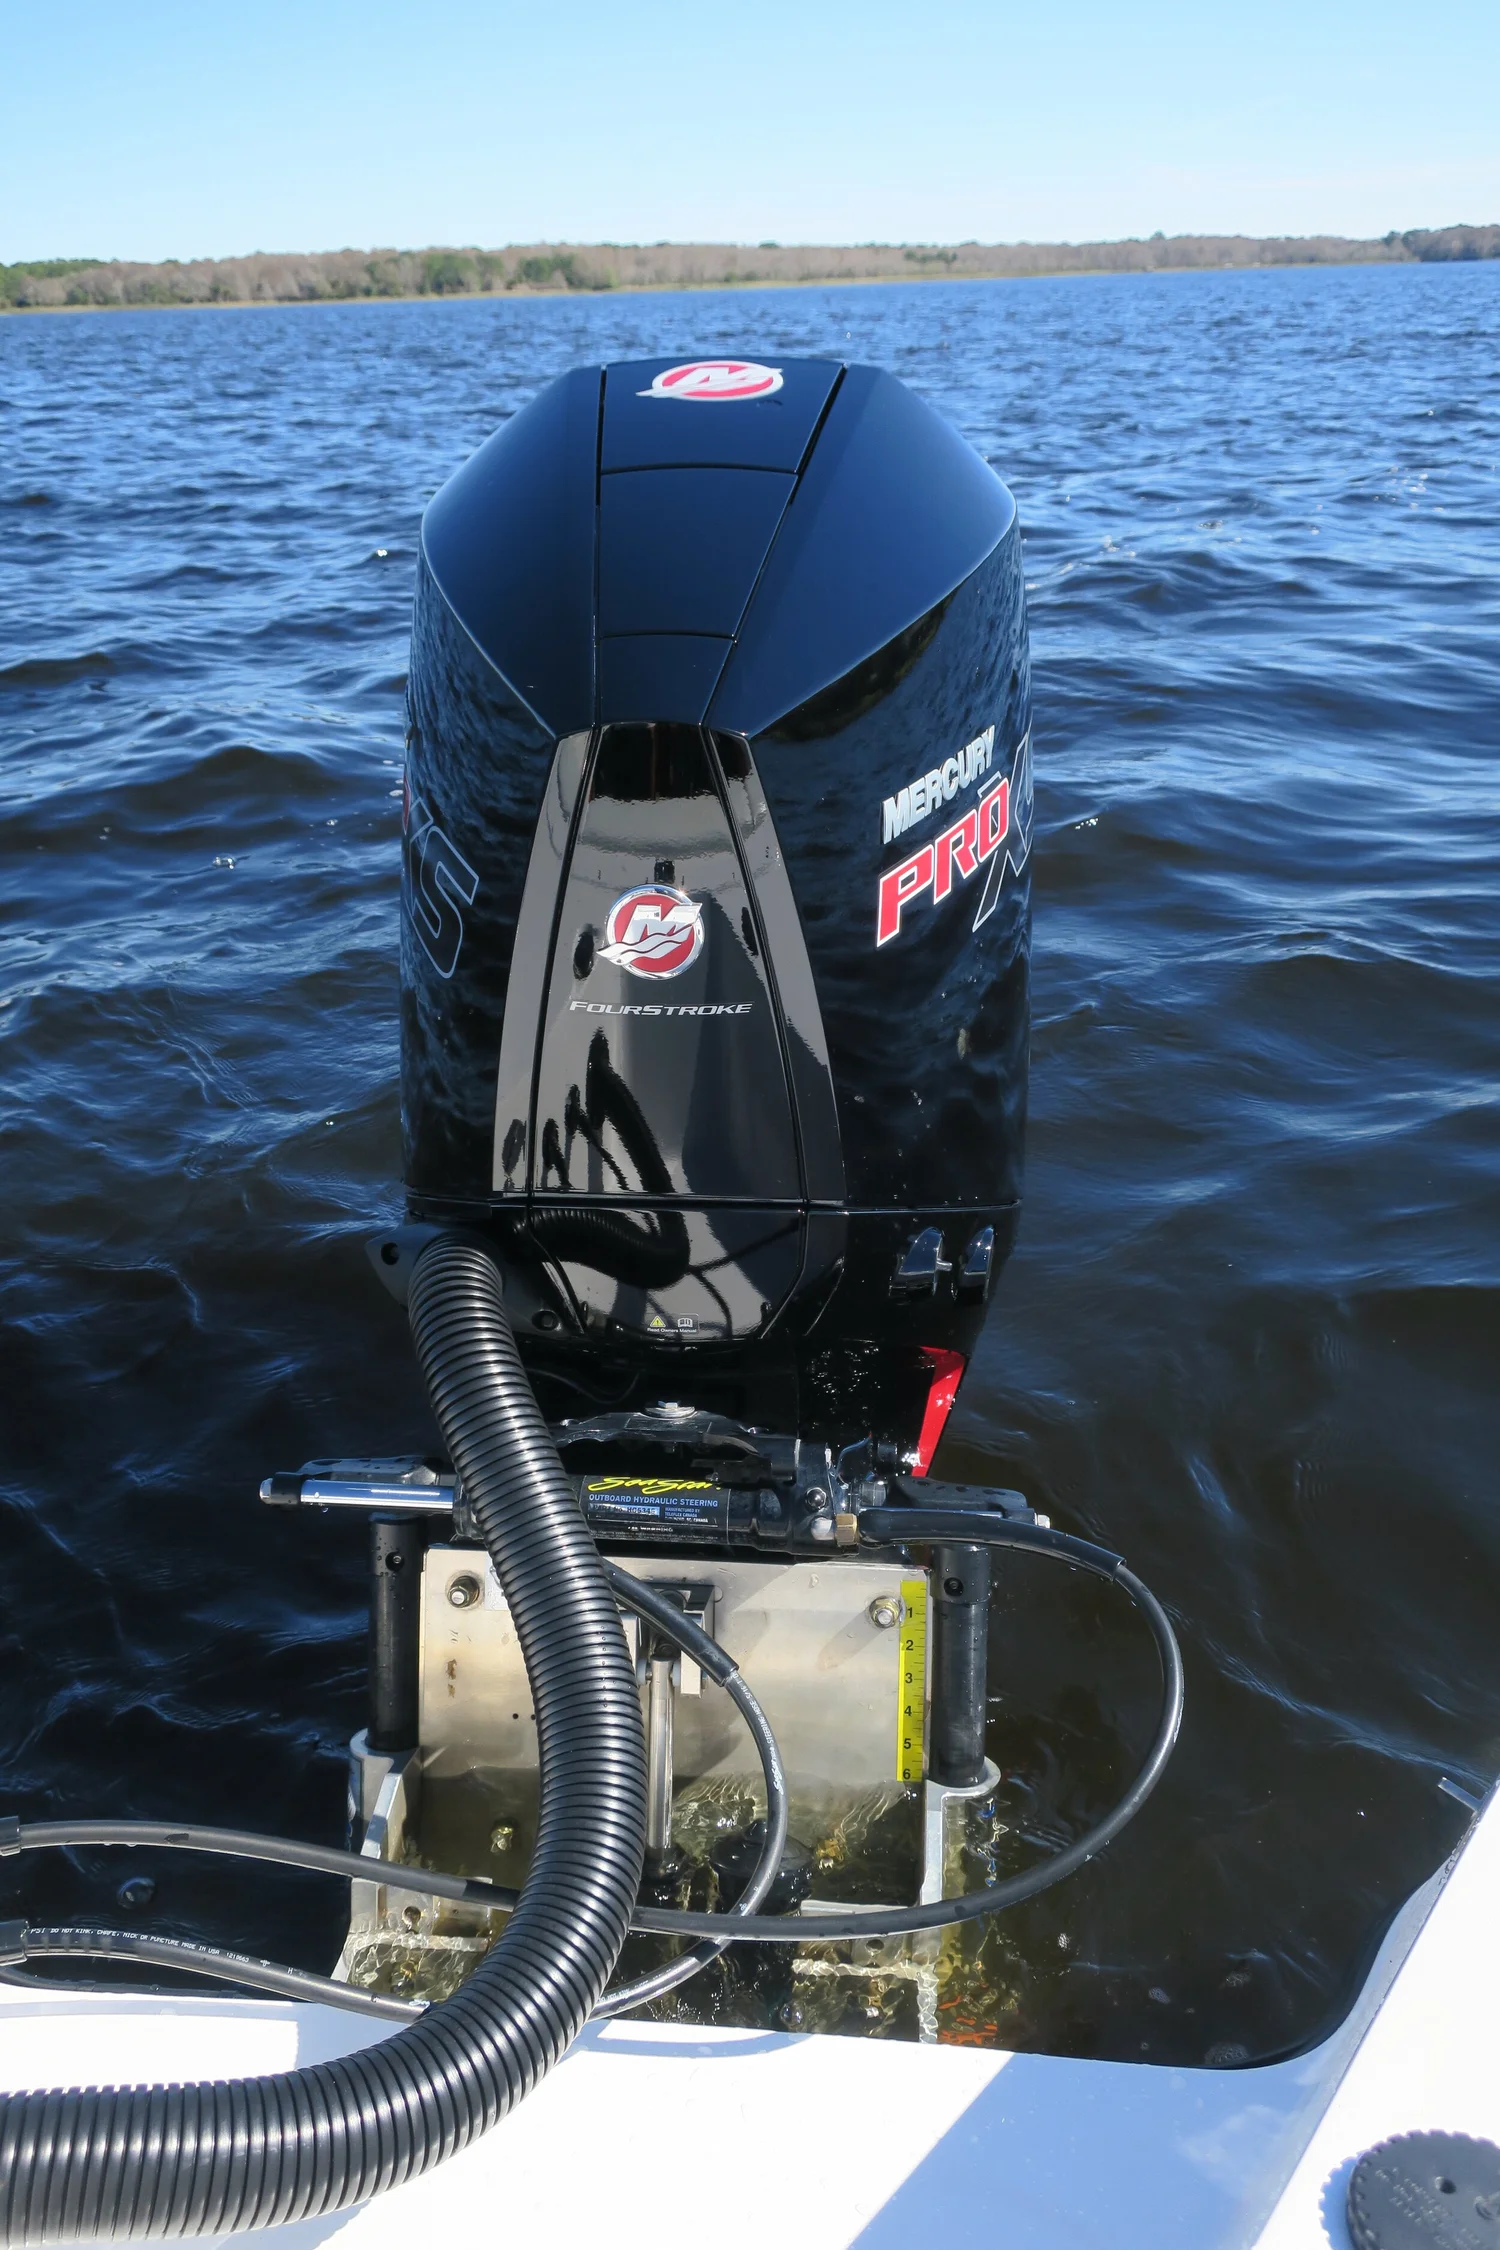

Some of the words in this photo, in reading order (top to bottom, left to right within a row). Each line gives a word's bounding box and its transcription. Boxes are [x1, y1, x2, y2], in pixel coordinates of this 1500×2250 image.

[880, 725, 995, 845] MERCURY
[876, 777, 1010, 948] PRO
[589, 1494, 632, 1503] OUTBOARD
[633, 1496, 678, 1505] HYDRAULIC
[680, 1499, 719, 1507] STEERING
[907, 1607, 913, 1618] 1
[906, 1639, 914, 1651] 2
[905, 1672, 913, 1684] 3
[750, 1699, 761, 1715] HOSE
[904, 1705, 912, 1717] 4
[758, 1716, 774, 1744] STEERING
[903, 1738, 911, 1750] 5
[903, 1768, 911, 1780] 6
[150, 1935, 180, 1946] PUNCTURE
[181, 1941, 196, 1950] MADE
